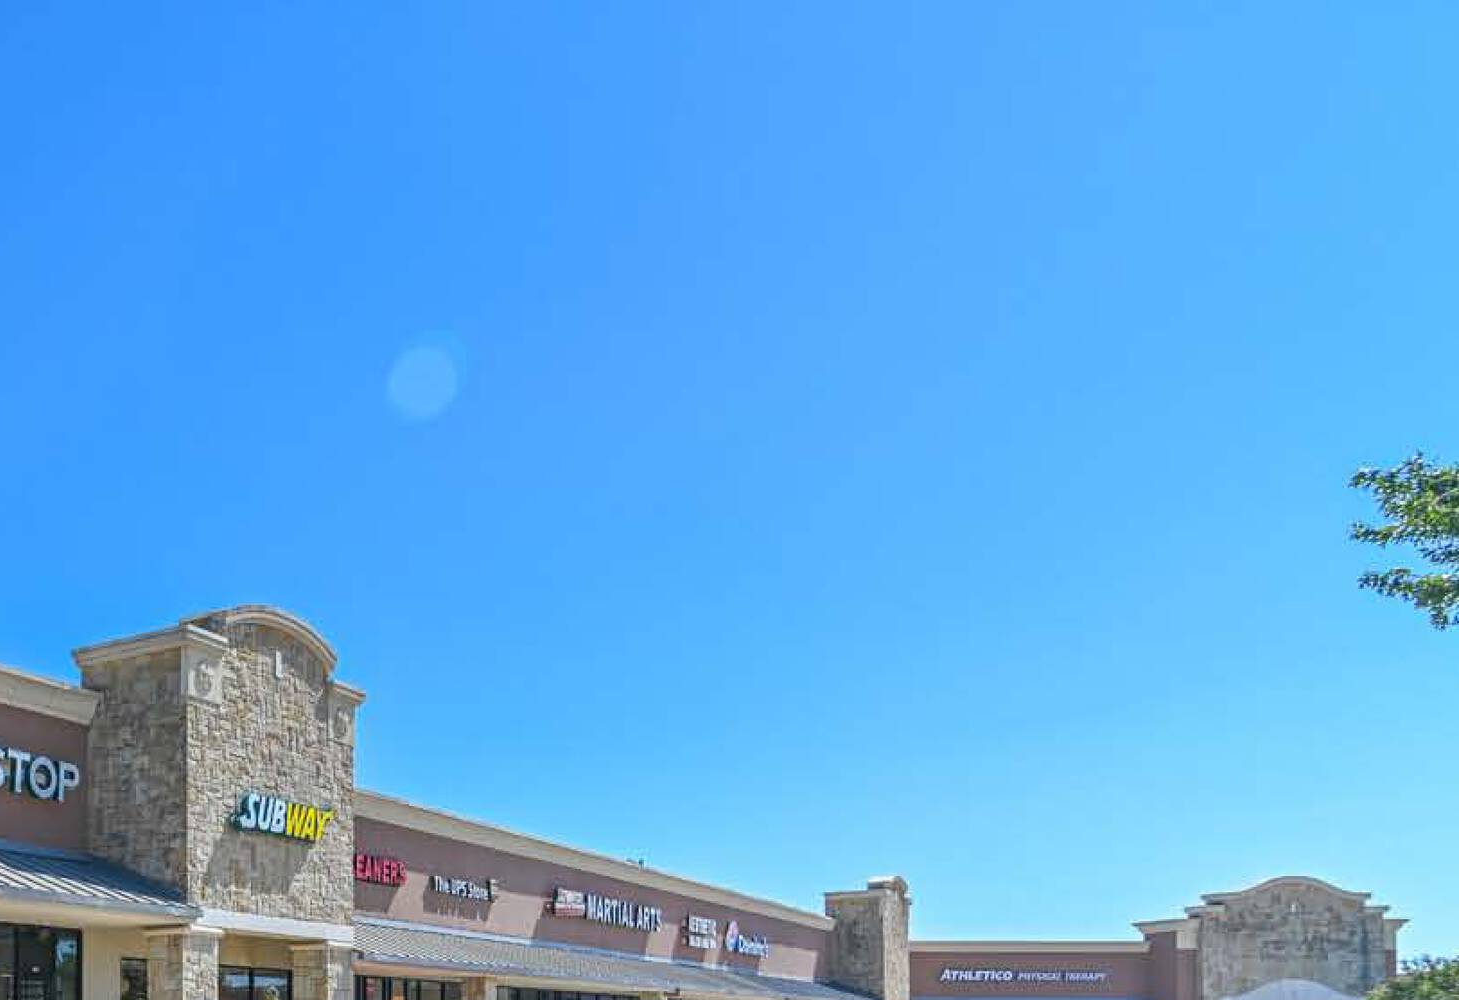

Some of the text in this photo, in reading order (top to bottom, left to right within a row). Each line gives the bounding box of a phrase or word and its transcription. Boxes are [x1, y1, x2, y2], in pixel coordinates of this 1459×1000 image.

[233, 792, 337, 842] SUBWAY
[355, 853, 409, 886] EANERS
[586, 893, 635, 929] MARTIAL
[636, 903, 663, 933] ARTS
[941, 968, 1012, 982] ATHLETICO
